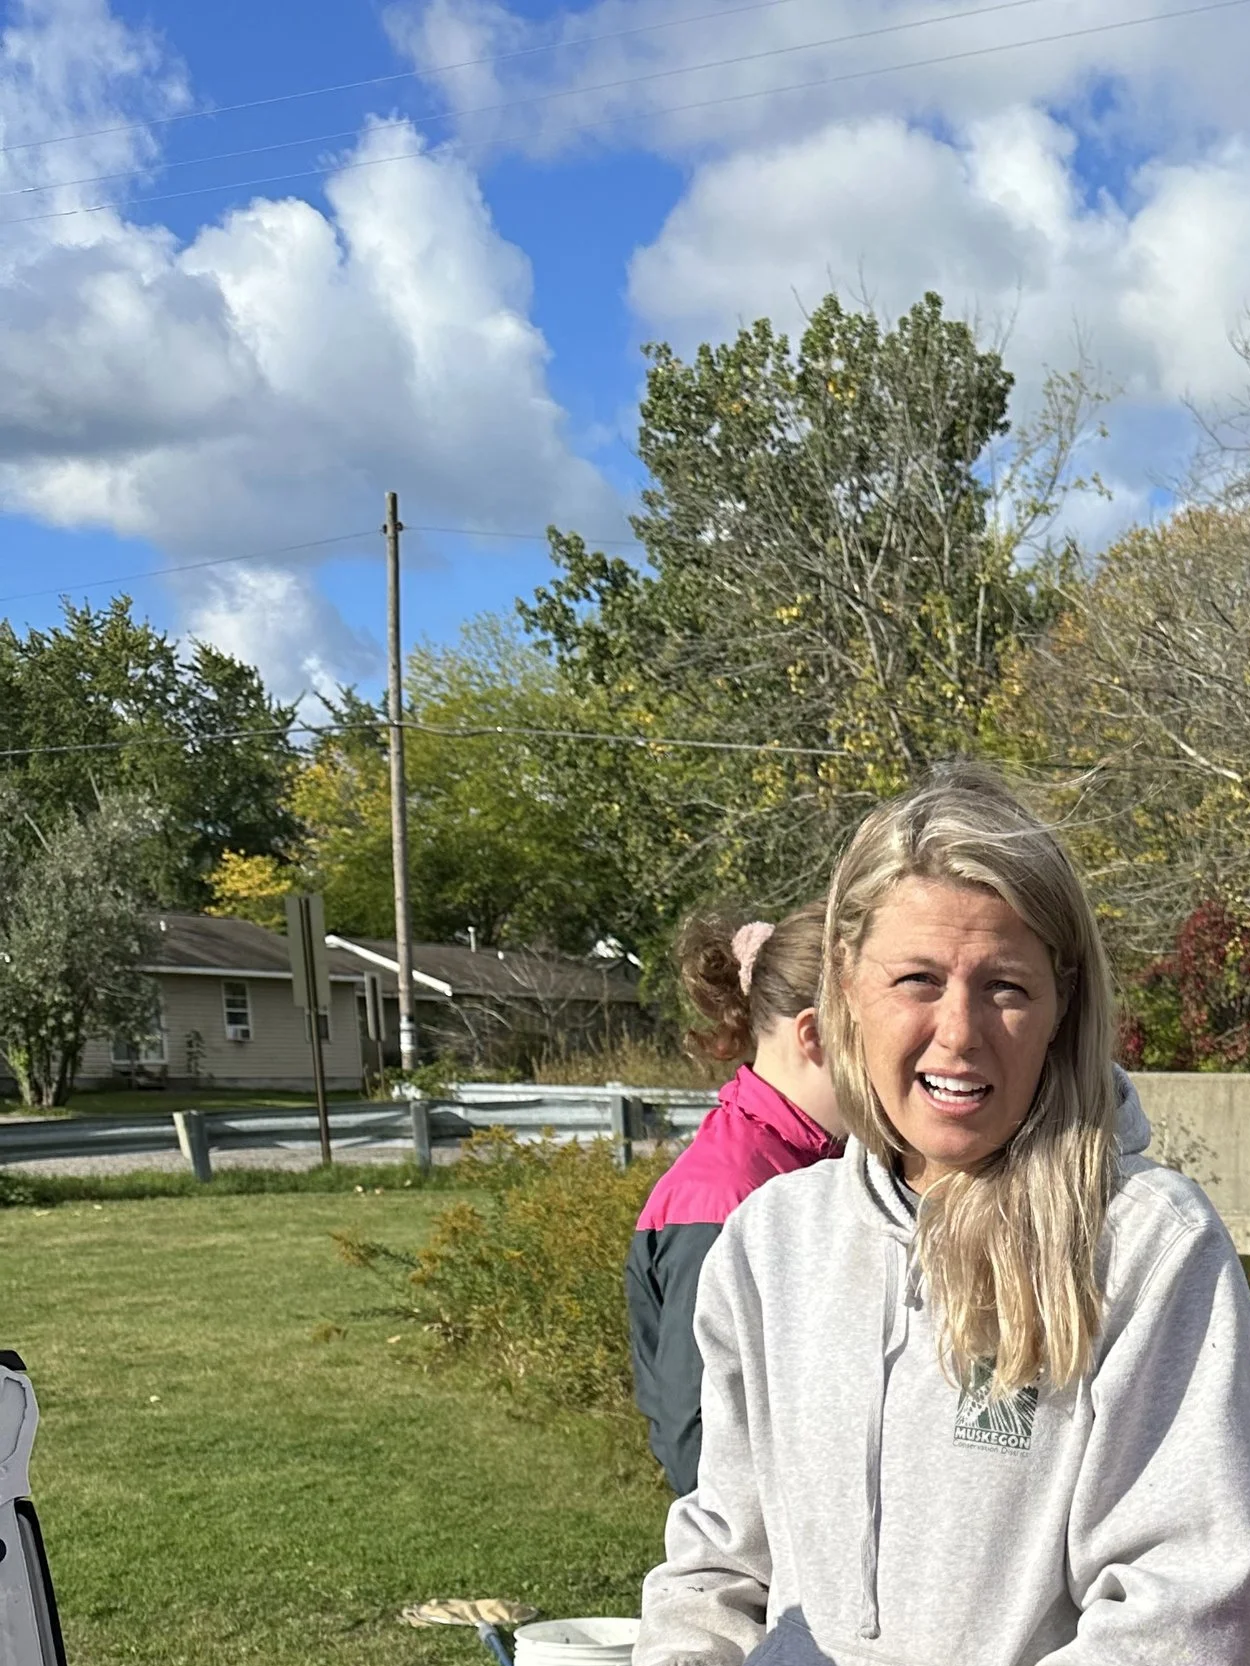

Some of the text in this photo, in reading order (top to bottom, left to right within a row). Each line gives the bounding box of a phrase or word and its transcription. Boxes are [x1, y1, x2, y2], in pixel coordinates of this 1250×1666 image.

[952, 1438, 1030, 1459] Conservation District
[955, 1427, 1031, 1450] MUSKEGON
